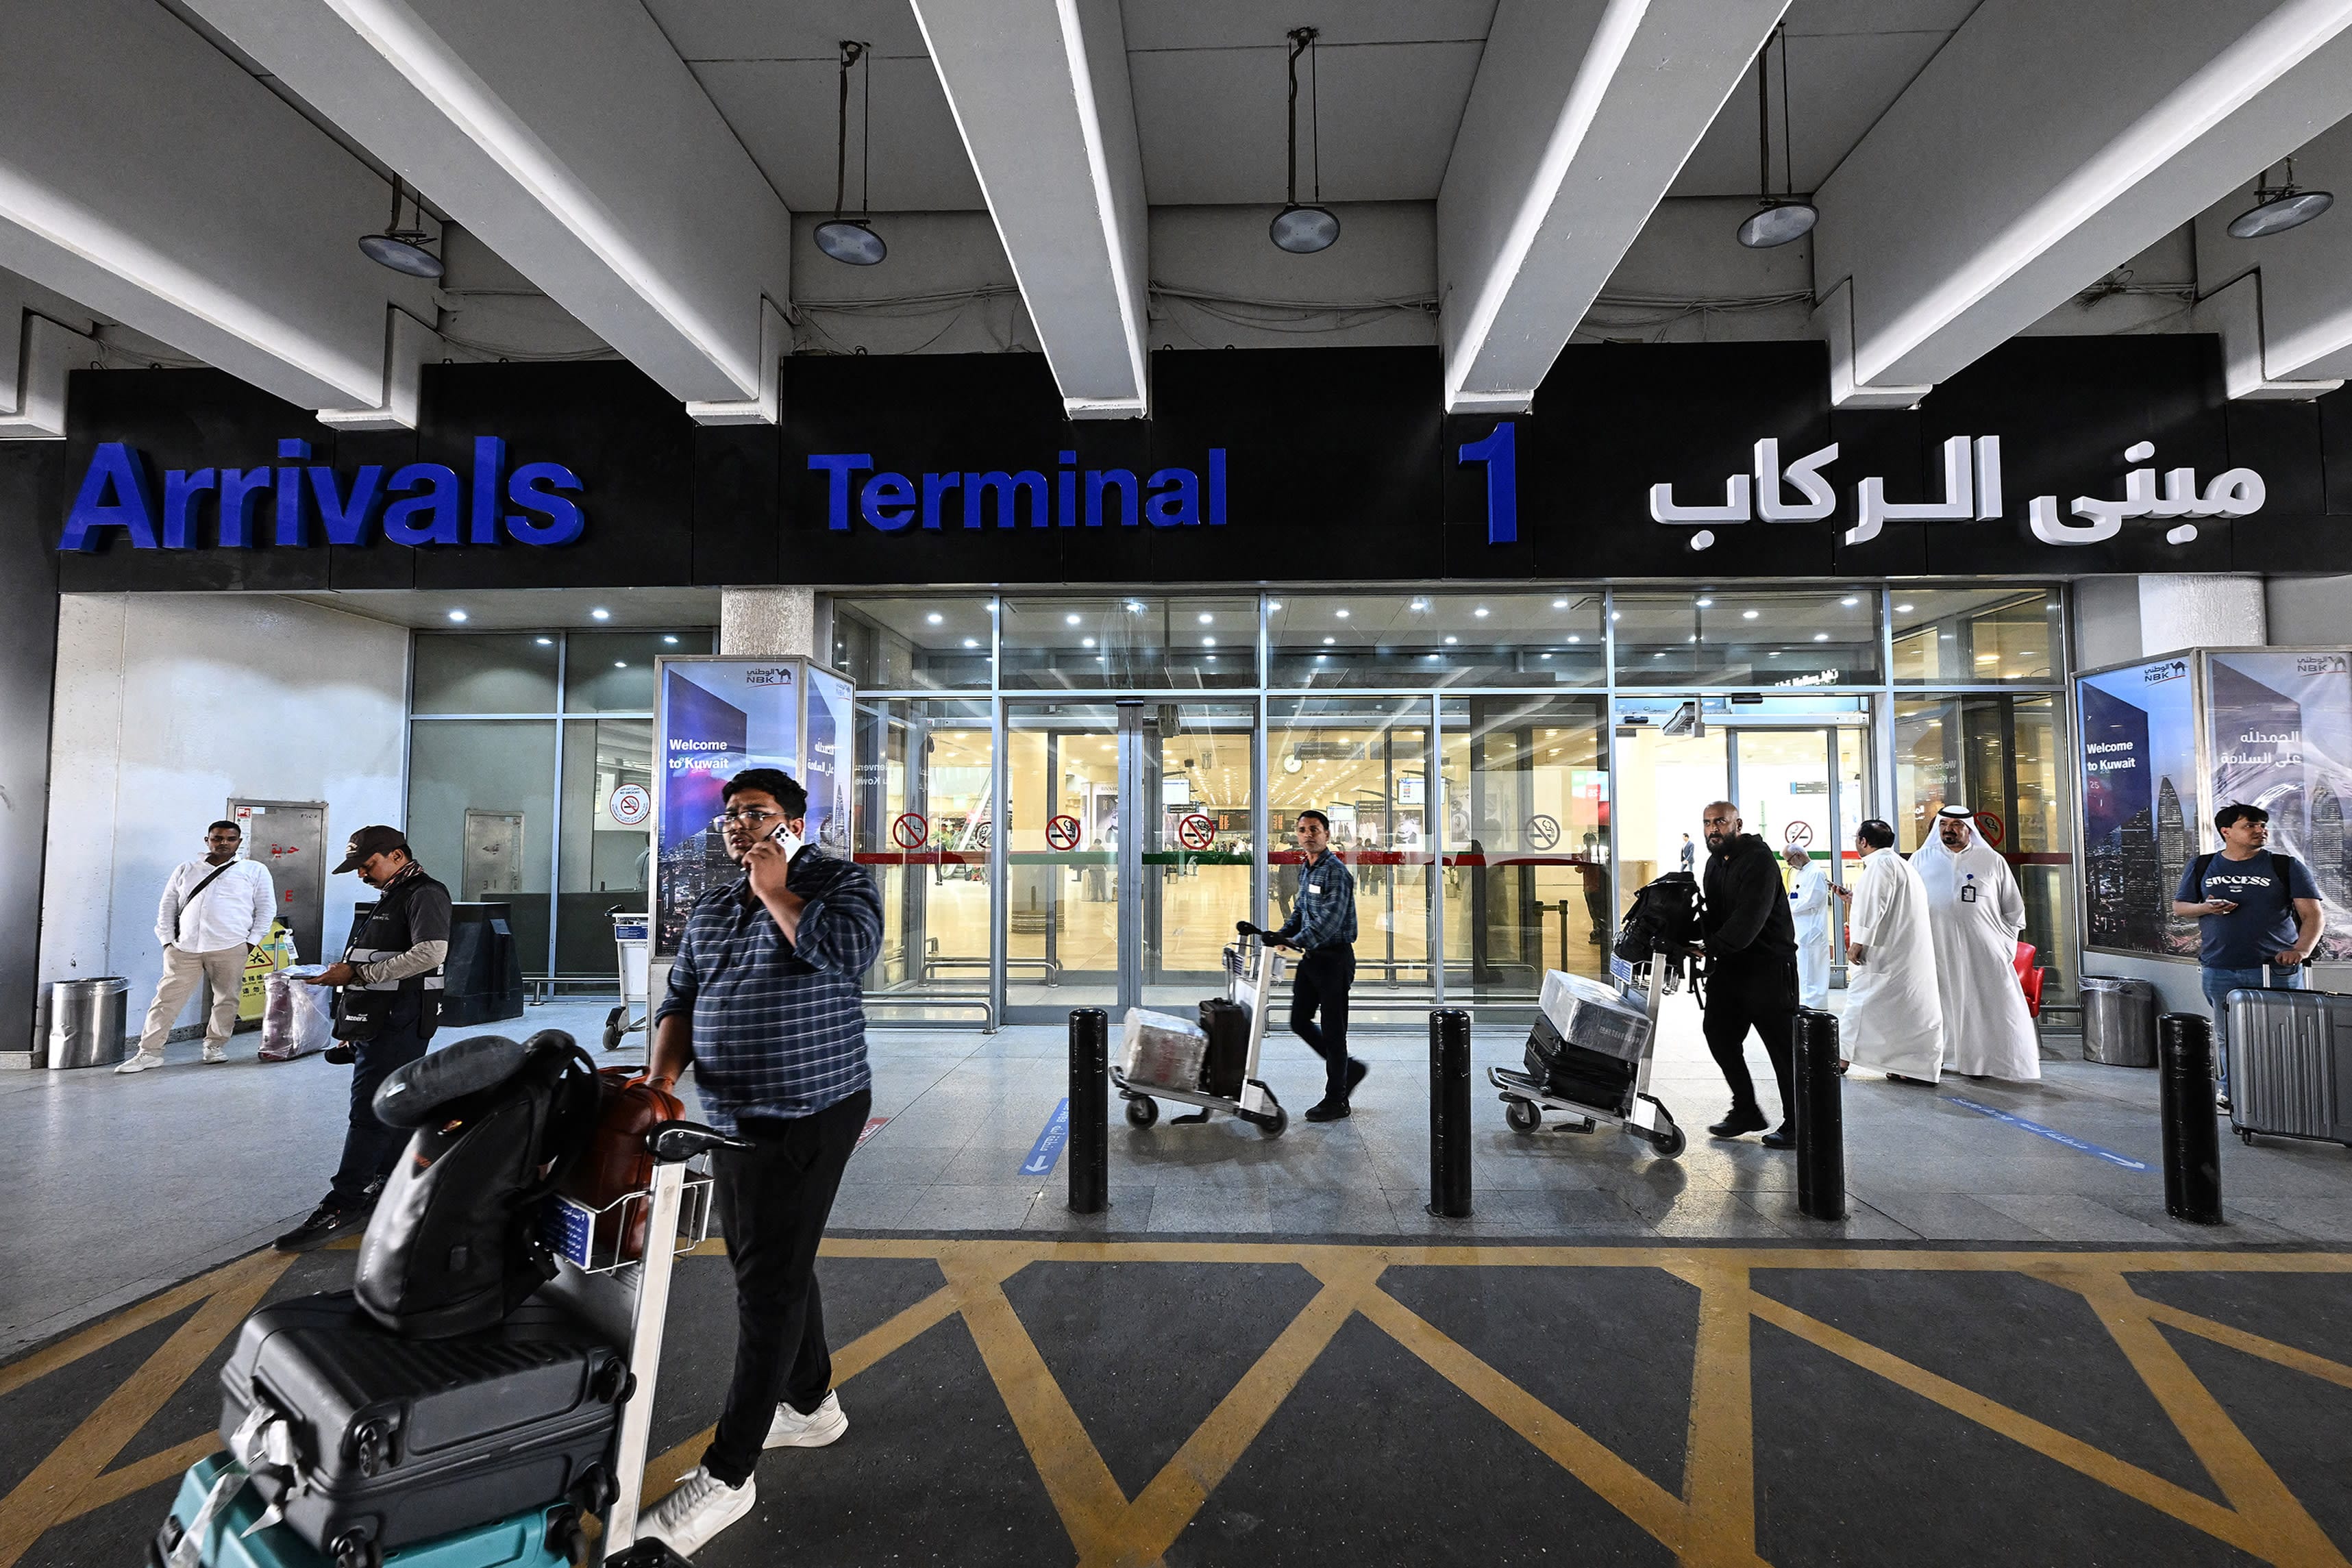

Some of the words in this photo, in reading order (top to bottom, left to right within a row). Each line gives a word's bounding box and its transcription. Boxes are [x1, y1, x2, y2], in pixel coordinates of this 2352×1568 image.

[808, 448, 1226, 531] Terminal
[1458, 422, 1517, 544] 1
[57, 436, 584, 551] Arrivals
[2029, 440, 2266, 545] مبنى
[746, 668, 775, 677] الوطني
[2144, 671, 2169, 682] NBK
[669, 738, 728, 751] Welcome
[2086, 741, 2133, 755] Welcome
[668, 758, 682, 769] to
[684, 756, 730, 769] Kuwait
[2087, 761, 2098, 771] to
[2099, 757, 2137, 771] Kuwait
[2205, 875, 2271, 888] SUCCESS
